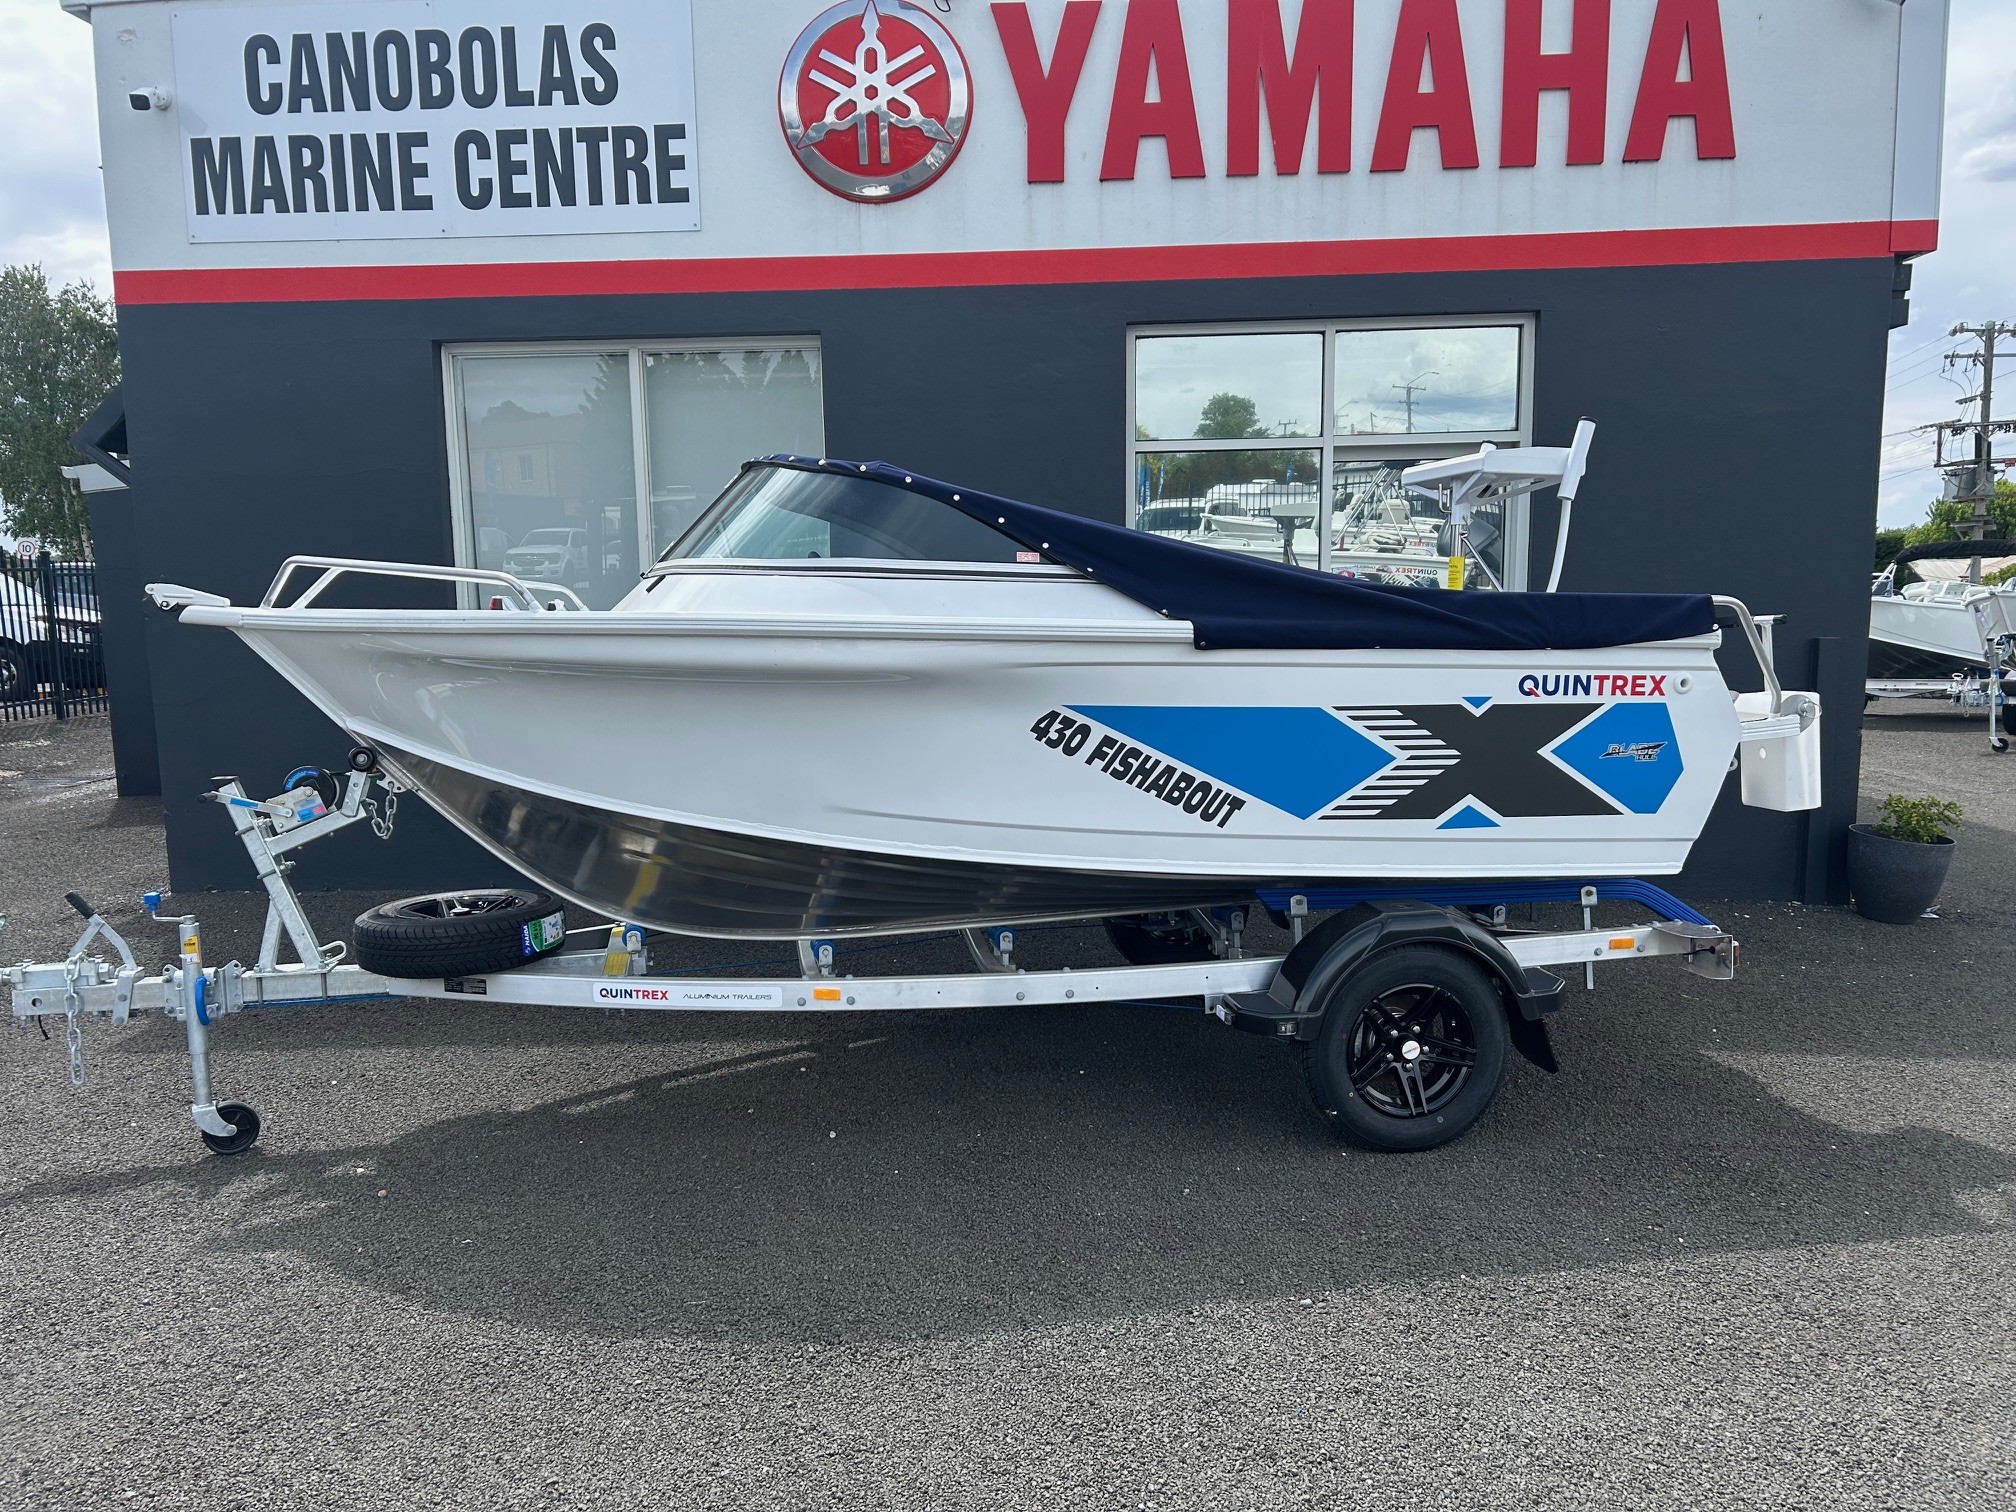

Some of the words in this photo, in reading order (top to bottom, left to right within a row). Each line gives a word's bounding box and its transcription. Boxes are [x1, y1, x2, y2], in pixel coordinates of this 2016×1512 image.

[243, 22, 620, 116] CANOBOLAS
[990, 0, 1735, 184] YAMAHA
[190, 131, 434, 216] MARINE
[453, 123, 691, 211] CENTRE
[21, 544, 32, 553] 10
[1518, 674, 1668, 698] QUINTREX
[1029, 709, 1092, 757] 430
[1084, 734, 1247, 829] FISHABOUT
[1604, 743, 1662, 755] BLADE
[599, 987, 670, 1001] QUINTREX
[683, 993, 730, 1001] ALUMINIUM
